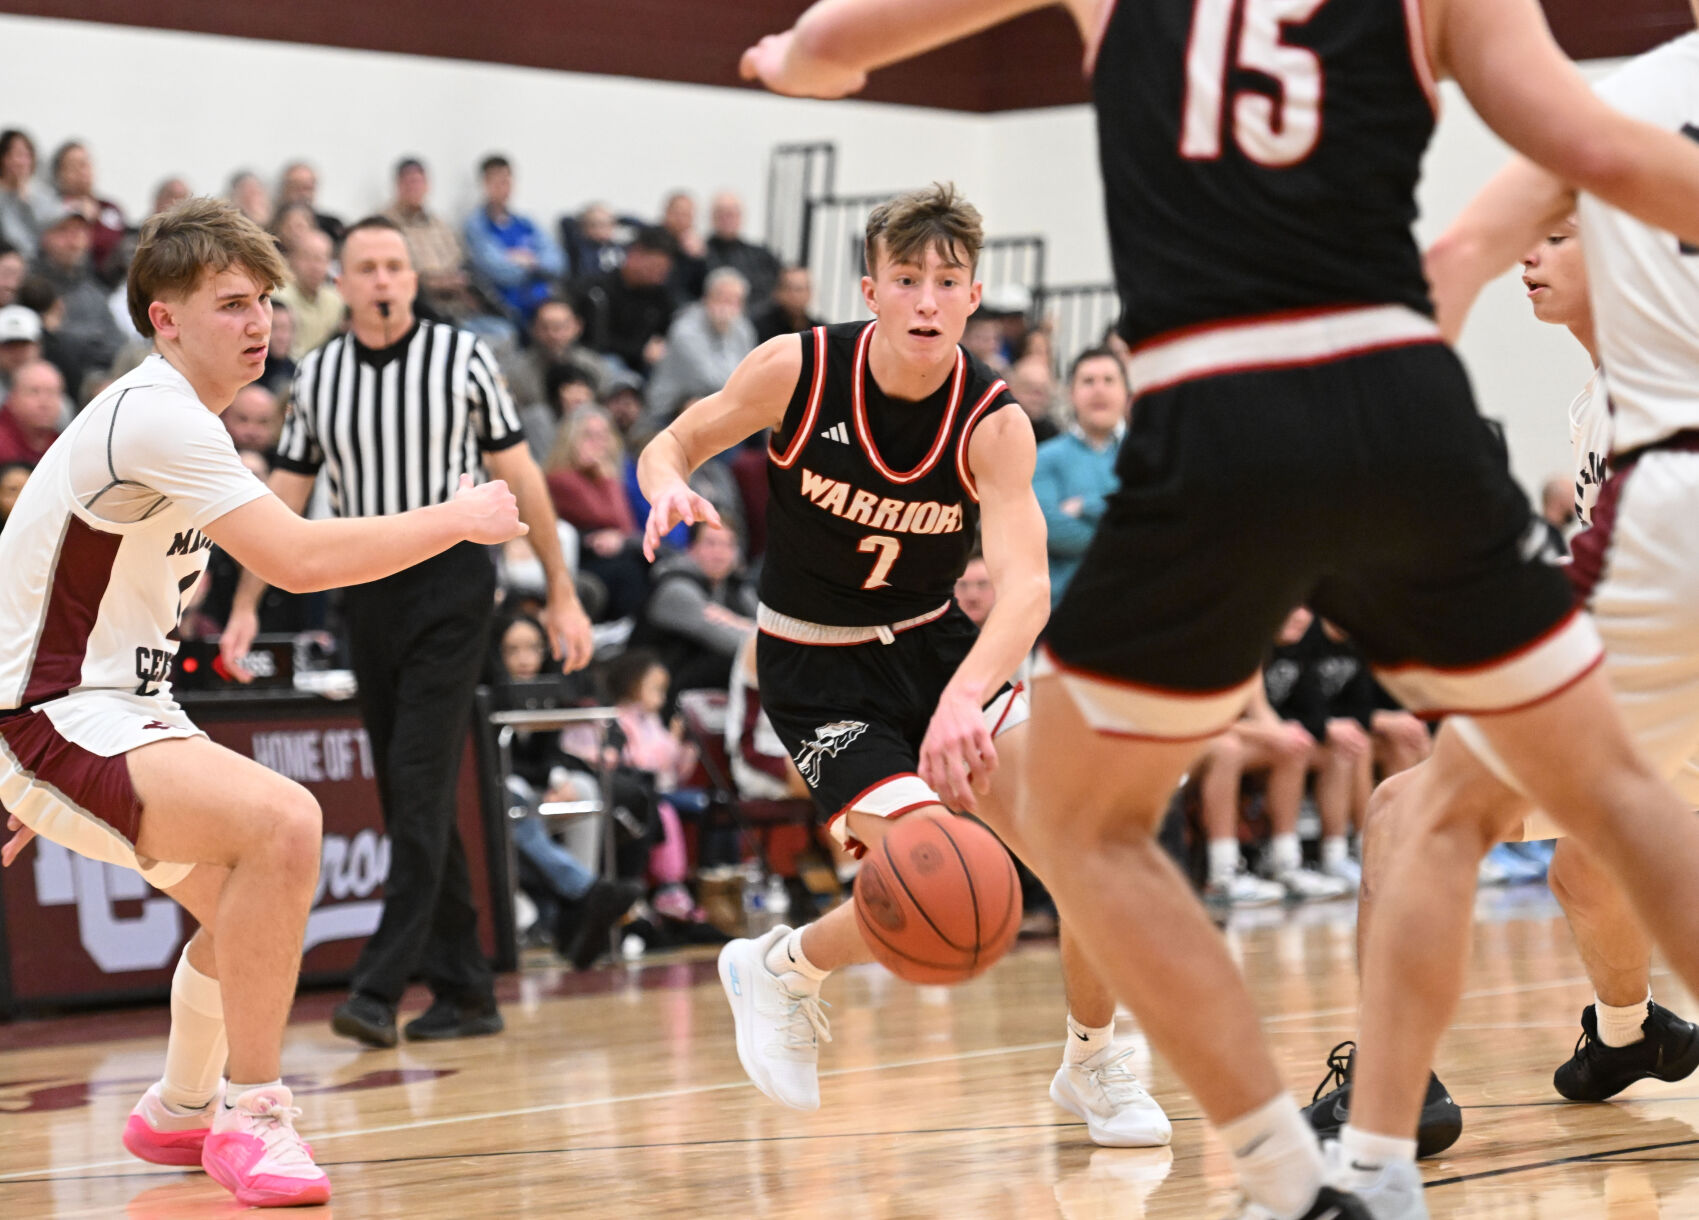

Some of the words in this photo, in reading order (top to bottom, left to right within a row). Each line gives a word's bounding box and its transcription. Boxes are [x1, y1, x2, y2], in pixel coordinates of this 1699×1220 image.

[1178, 0, 1325, 167] 15
[252, 730, 324, 782] HOME
[323, 728, 356, 781] OF
